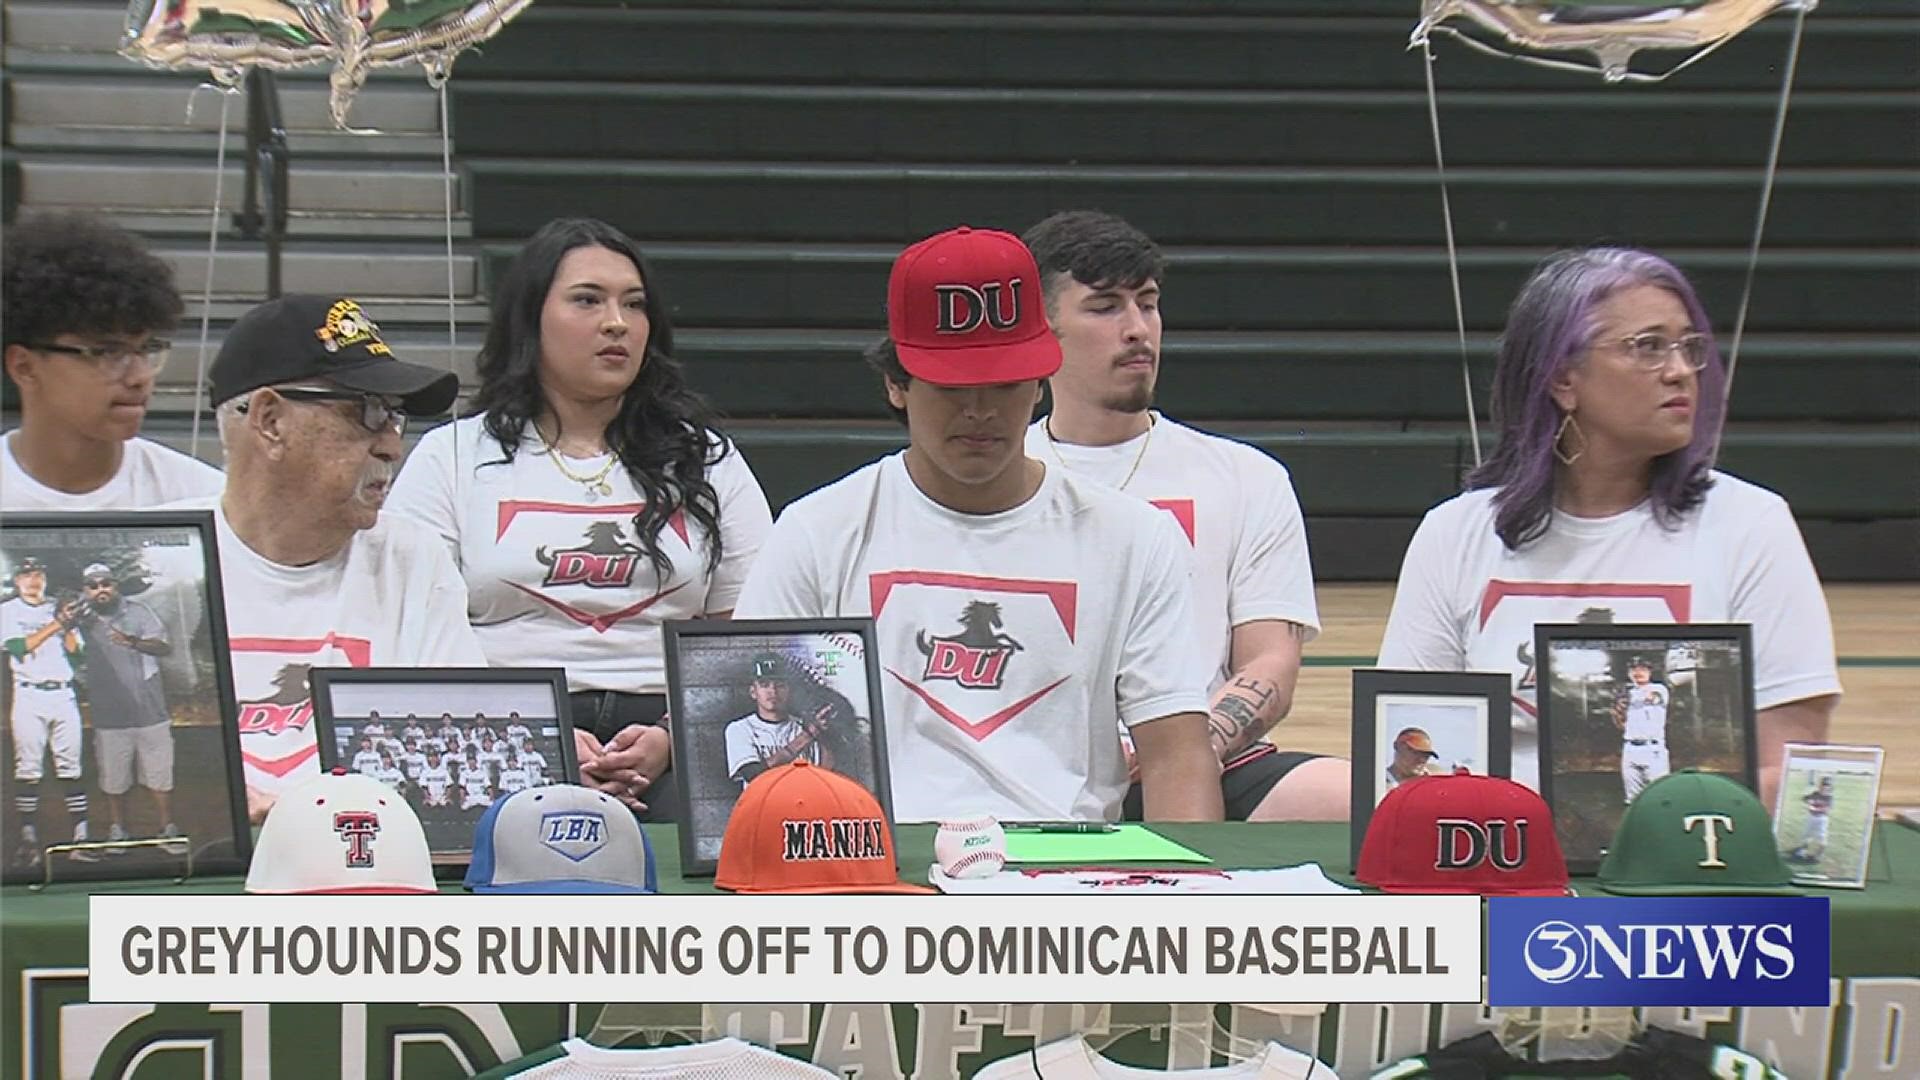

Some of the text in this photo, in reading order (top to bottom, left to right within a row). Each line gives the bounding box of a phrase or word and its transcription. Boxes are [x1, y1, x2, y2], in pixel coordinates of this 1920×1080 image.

[935, 278, 1023, 334] DU
[543, 551, 640, 587] DU
[924, 639, 1014, 689] DU
[547, 819, 600, 842] LBA
[782, 818, 886, 861] MANIAX
[1434, 818, 1528, 871] DU
[1683, 814, 1733, 868] T
